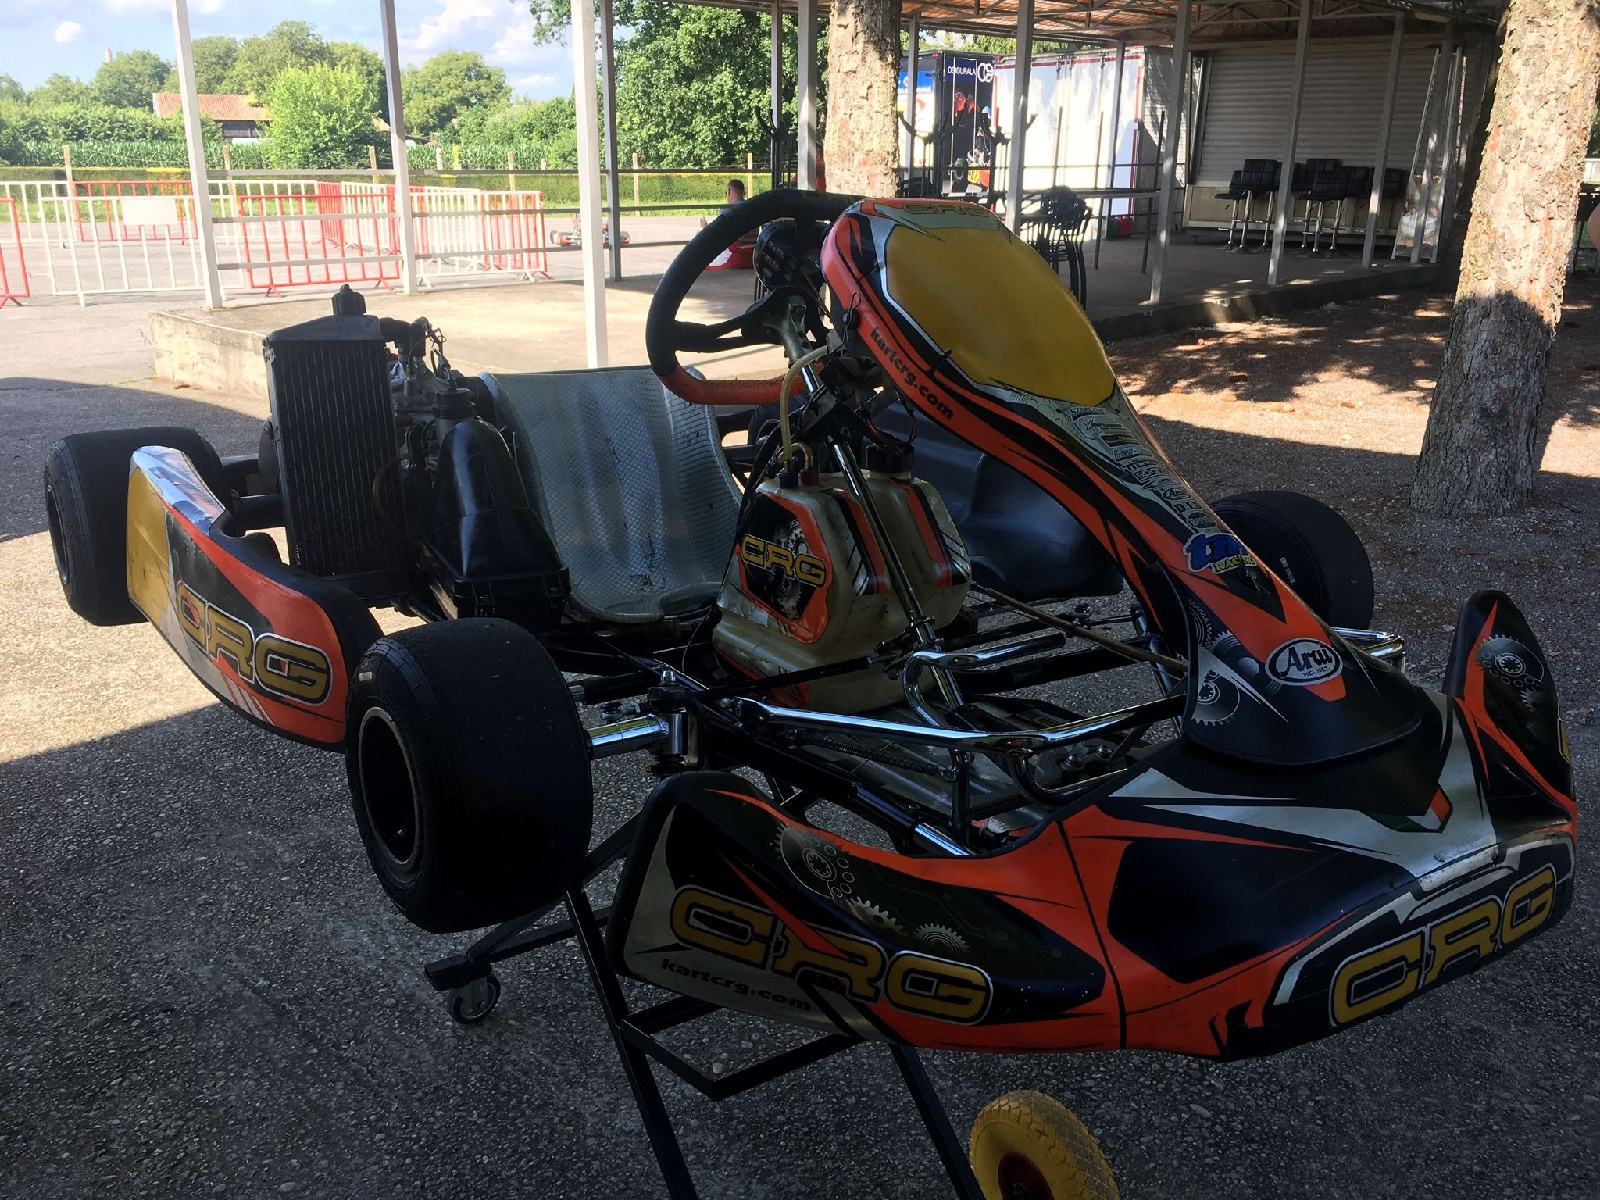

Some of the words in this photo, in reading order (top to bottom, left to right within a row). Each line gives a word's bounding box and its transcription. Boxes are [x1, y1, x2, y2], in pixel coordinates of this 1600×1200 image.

[870, 326, 954, 420] kartcrg.com
[740, 534, 828, 588] CRG
[177, 579, 333, 706] CRG
[661, 958, 811, 1011] kartcrg.com
[670, 884, 993, 1026] CRG
[1329, 863, 1557, 1027] CRG
